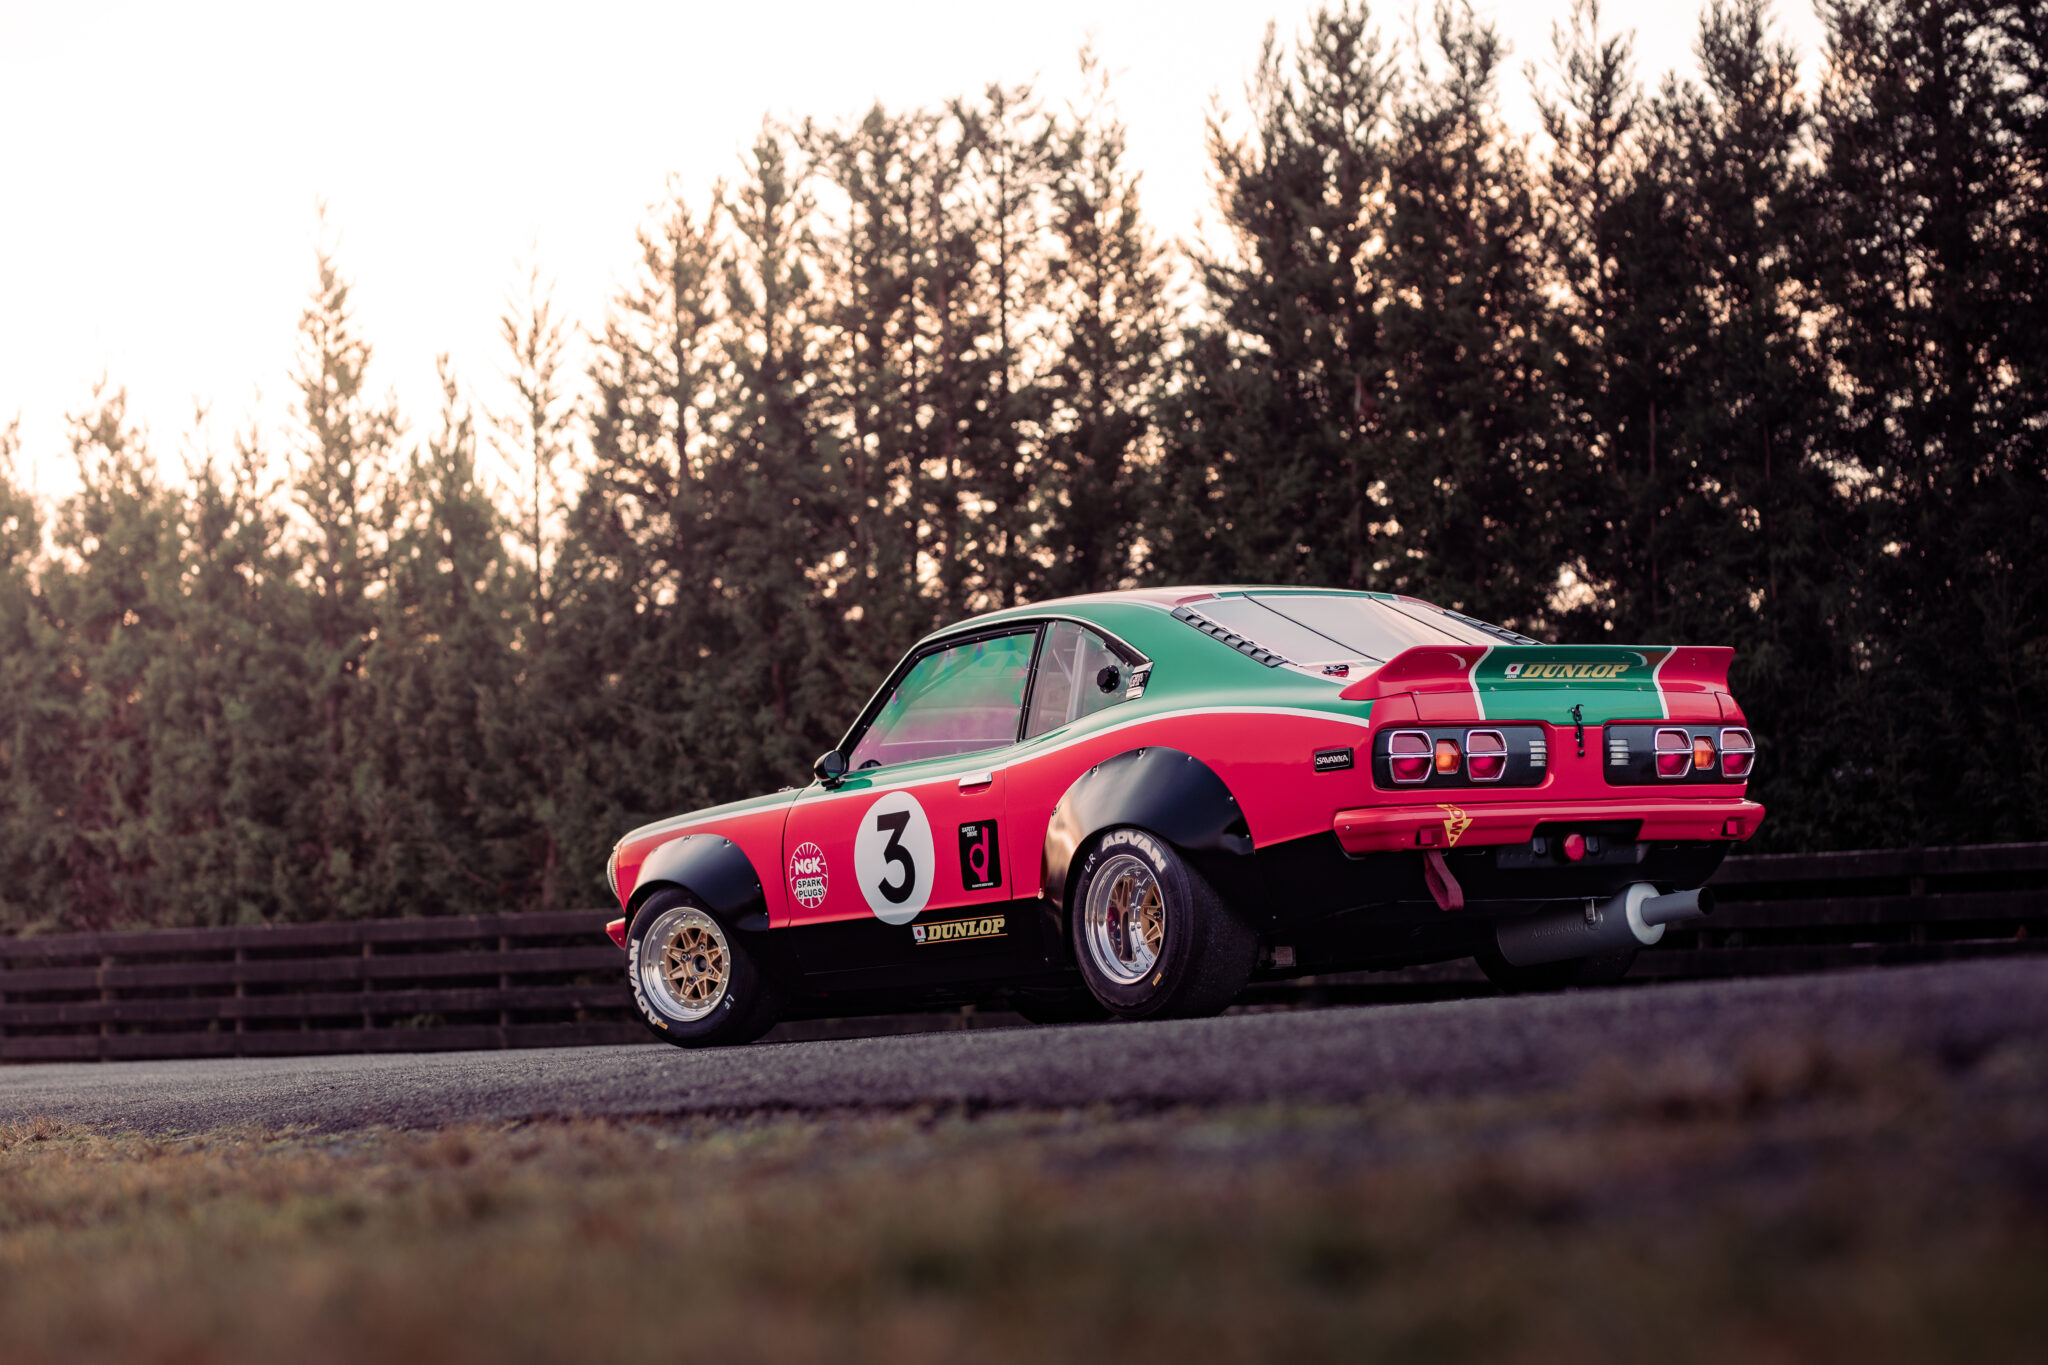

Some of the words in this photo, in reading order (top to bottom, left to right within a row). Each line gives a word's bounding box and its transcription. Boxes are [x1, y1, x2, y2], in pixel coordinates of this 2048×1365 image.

[1521, 664, 1630, 678] DUNLOP
[1316, 754, 1349, 765] SAVANNA
[876, 810, 916, 904] 3
[1101, 830, 1167, 873] ADVAN
[794, 856, 822, 875] NGK
[797, 878, 822, 889] SPARK
[798, 888, 823, 898] PLUGS
[927, 917, 1006, 941] DUNLOP
[628, 938, 665, 1026] ADVAN
